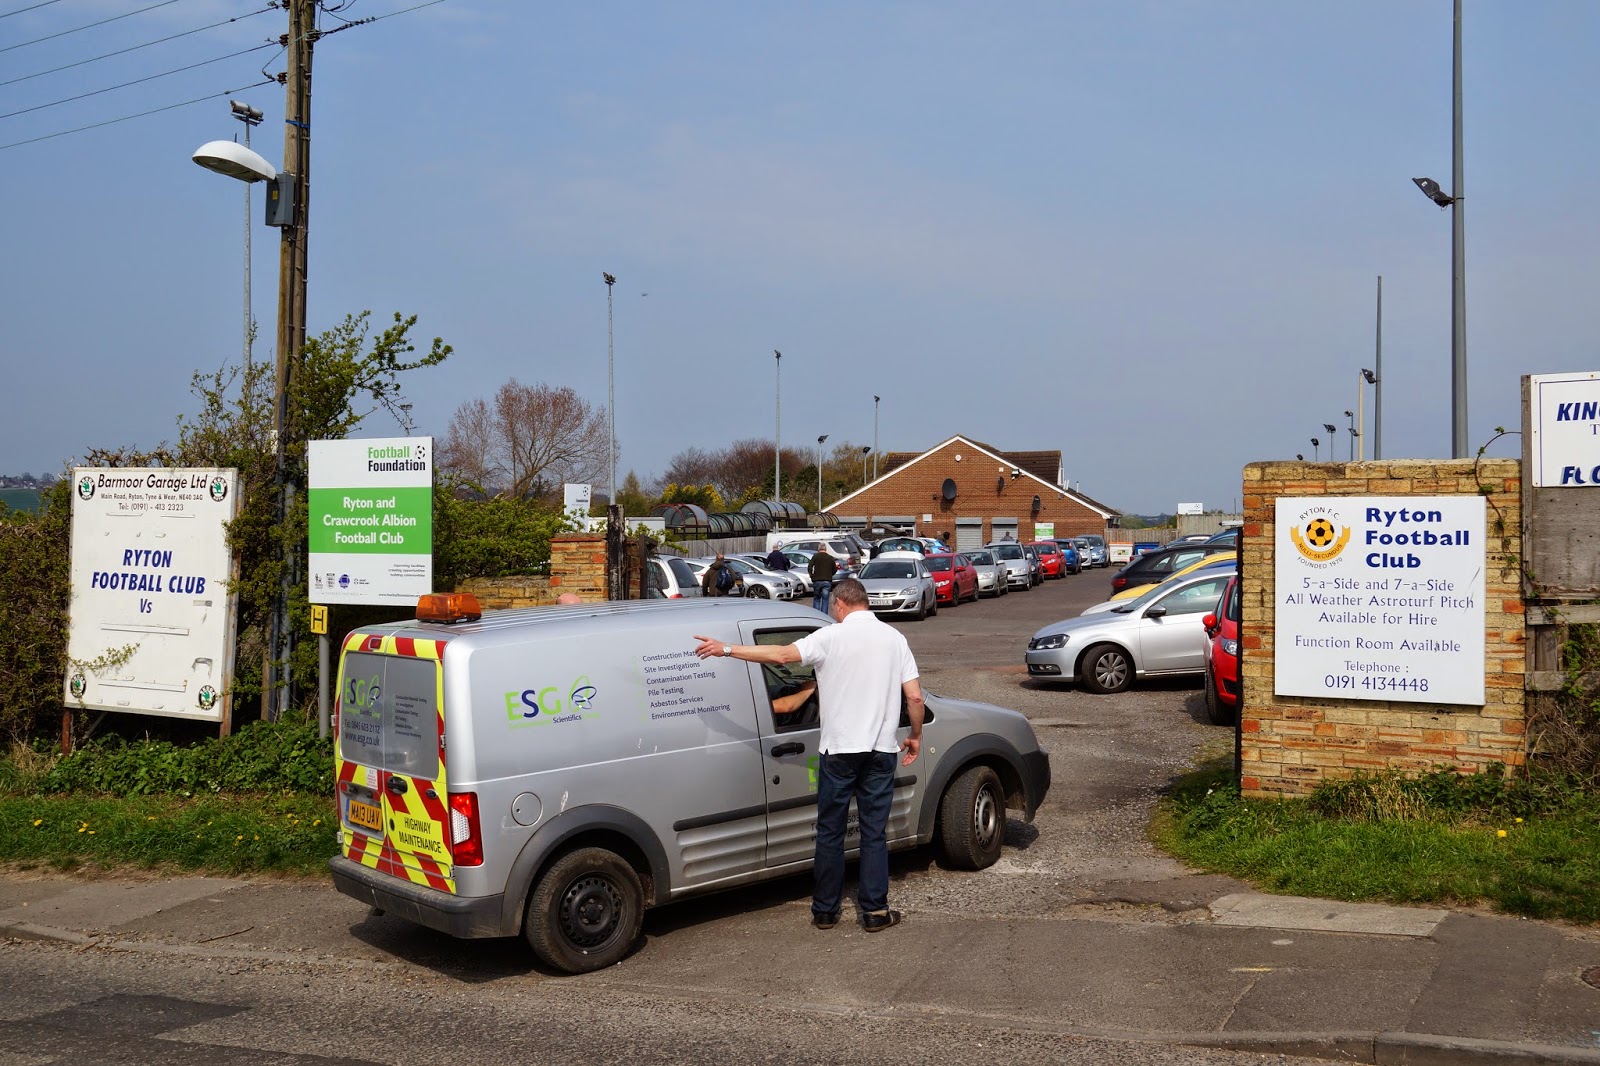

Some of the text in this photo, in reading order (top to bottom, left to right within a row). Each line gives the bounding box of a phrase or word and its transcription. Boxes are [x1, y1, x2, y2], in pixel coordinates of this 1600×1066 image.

[1557, 402, 1600, 421] KIN
[368, 446, 410, 458] Football
[368, 460, 425, 472] Foundation
[98, 474, 208, 491] Barmoor Garage Ltd
[131, 503, 149, 511] (0191)
[343, 496, 396, 512] Ryton and
[323, 514, 416, 526] Crawcrook Albion
[1299, 506, 1326, 521] RYTON
[1366, 507, 1442, 527] Ryton
[335, 532, 404, 544] Football Club
[1366, 530, 1469, 546] Football
[122, 549, 173, 568] RYTON
[1297, 556, 1328, 570] FOUNDED
[1366, 553, 1421, 568] Club
[91, 572, 206, 594] FOOTBALL CLUB
[1303, 577, 1454, 592] 5-a-Side and 7-a-Side
[140, 598, 153, 614] Vs
[1285, 593, 1474, 609] All Weather Astroturf Pitch
[1319, 611, 1438, 626] Available for Hire
[1295, 635, 1461, 652] Function Room Available
[642, 652, 683, 662] Construction
[644, 661, 700, 674] Site Investigations
[1344, 660, 1401, 675] Telephone
[646, 671, 716, 685] Contamination Testing
[1324, 675, 1429, 693] 0191 4134448
[344, 677, 366, 706] ESG
[648, 686, 684, 697] Pile Testing
[505, 686, 562, 721] ESG
[650, 696, 704, 709] Asbestos Services
[552, 713, 582, 724] Scientifics
[651, 703, 731, 720] Environmental Monitoring
[345, 732, 380, 747] www.esg.co.uk
[404, 816, 432, 835] HIGHWAY
[398, 830, 442, 854] MAINTENANCE
